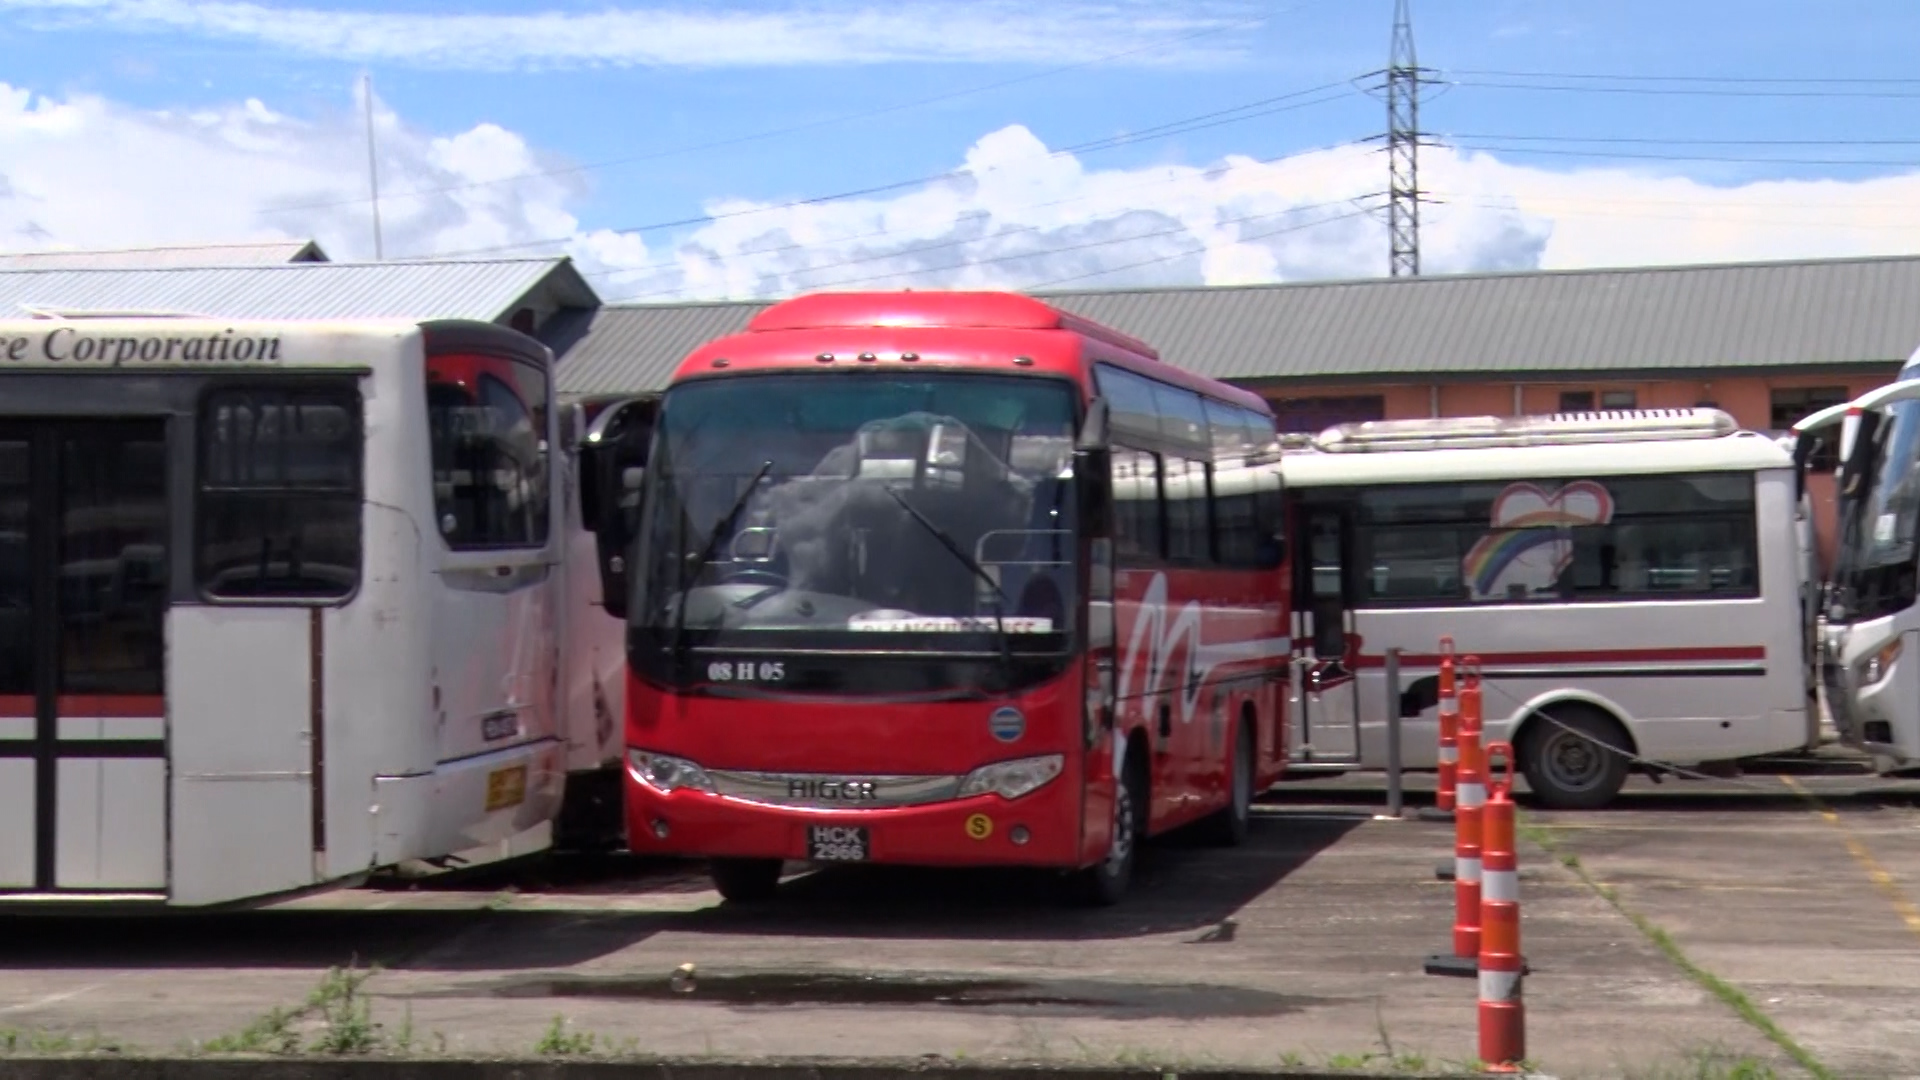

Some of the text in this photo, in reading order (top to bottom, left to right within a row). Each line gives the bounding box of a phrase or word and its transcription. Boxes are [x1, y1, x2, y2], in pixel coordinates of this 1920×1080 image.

[43, 327, 281, 367] Corporation
[737, 662, 755, 680] H
[760, 662, 785, 680] 05
[789, 780, 876, 799] HIGER
[813, 827, 861, 843] HCK
[972, 817, 985, 836] S
[814, 843, 865, 860] 2966
